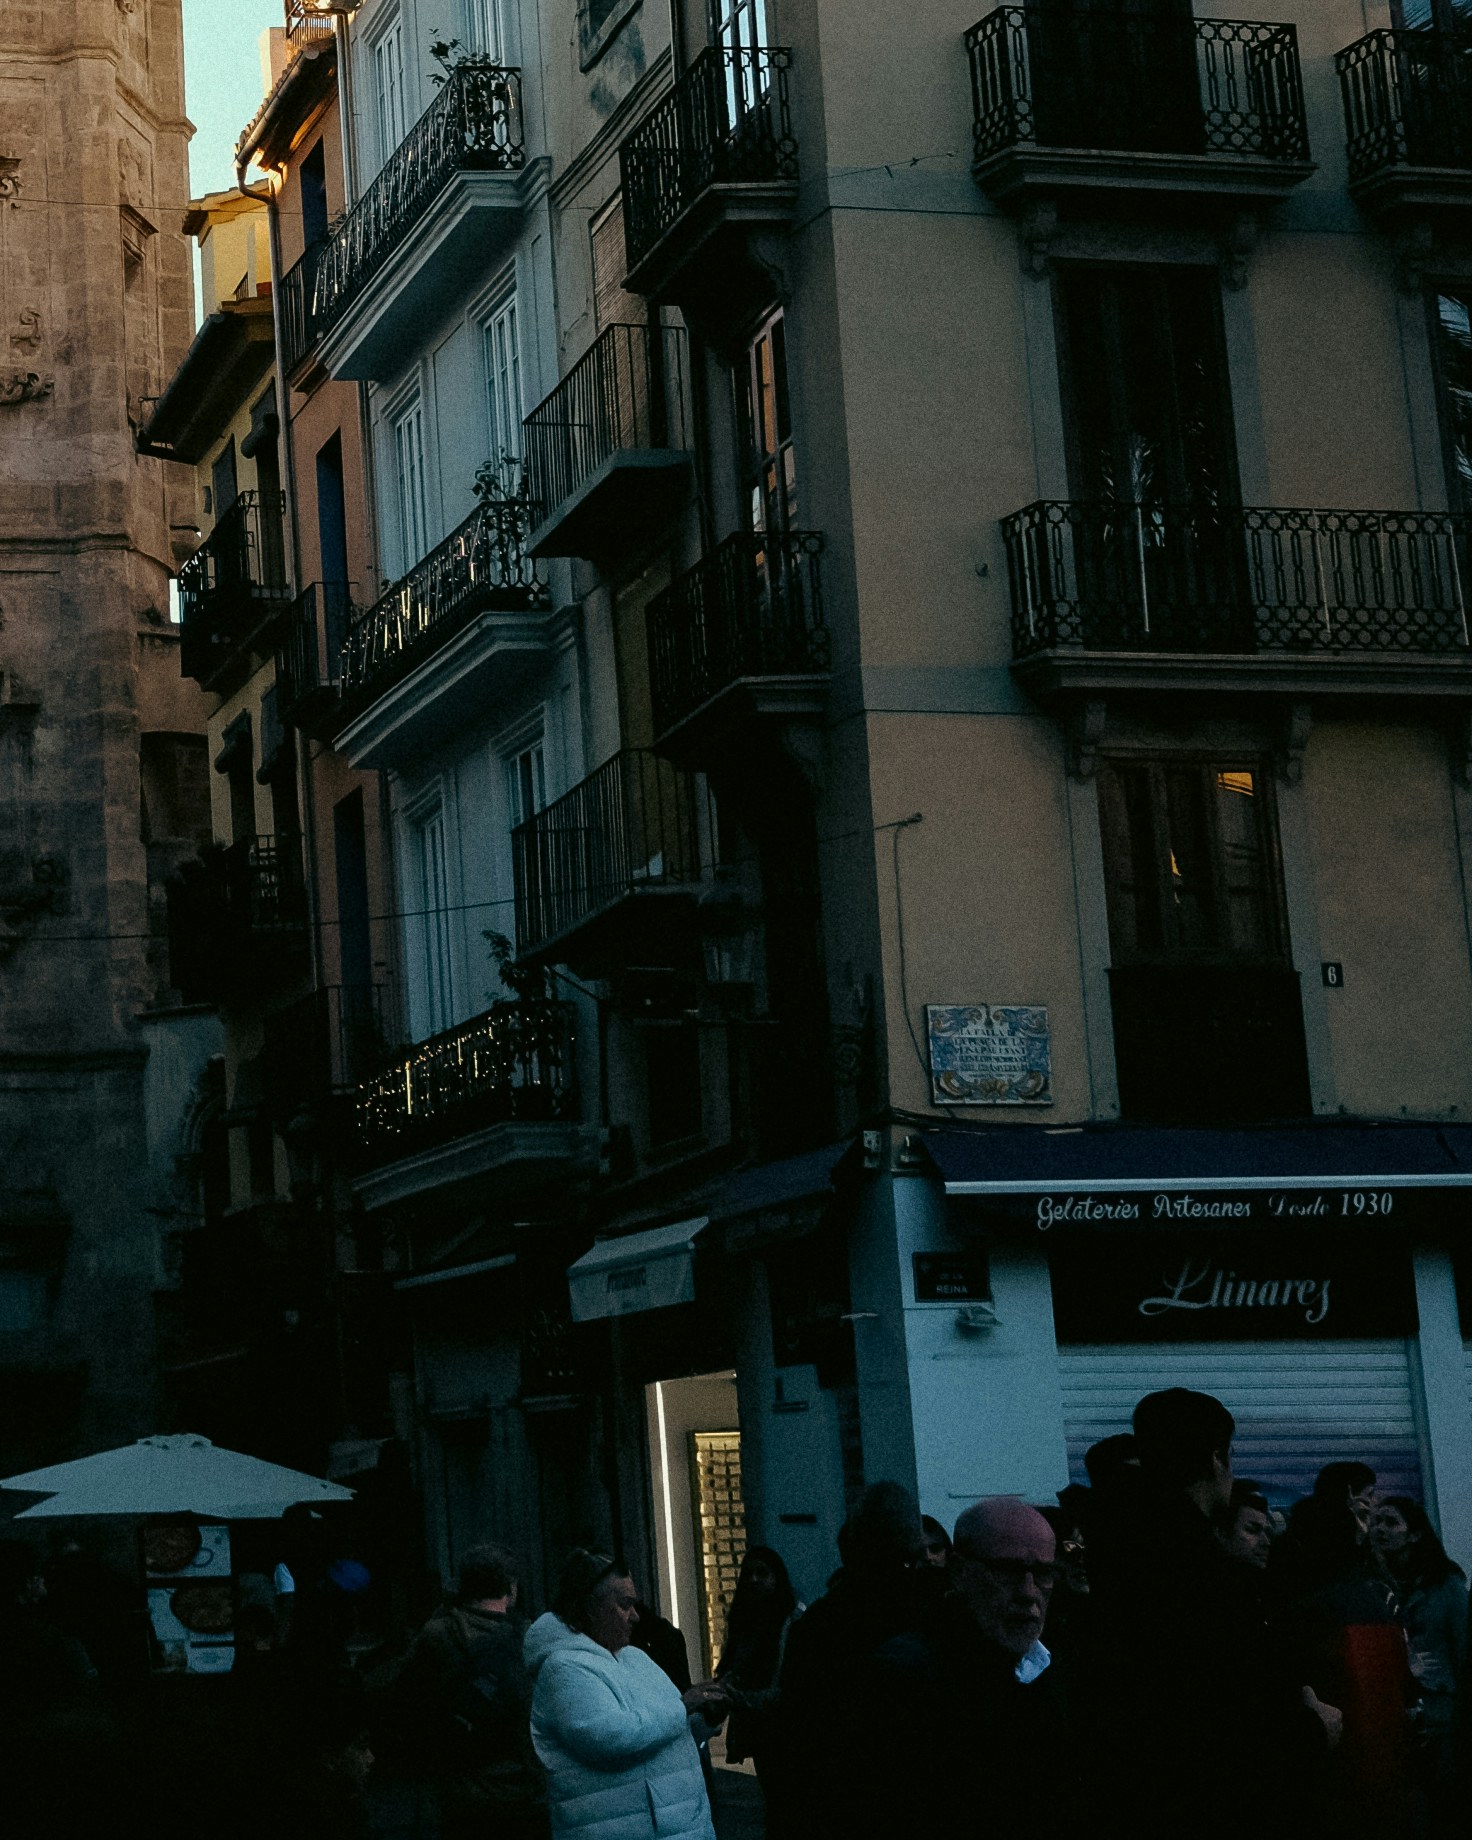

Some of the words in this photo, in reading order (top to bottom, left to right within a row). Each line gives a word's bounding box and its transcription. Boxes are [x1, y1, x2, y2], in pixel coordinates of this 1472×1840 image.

[1327, 965, 1338, 985] 6
[1037, 1194, 1140, 1232] Gelateries
[1152, 1193, 1252, 1220] Artesanes
[1339, 1192, 1393, 1217] 1930
[936, 1284, 969, 1294] REINA
